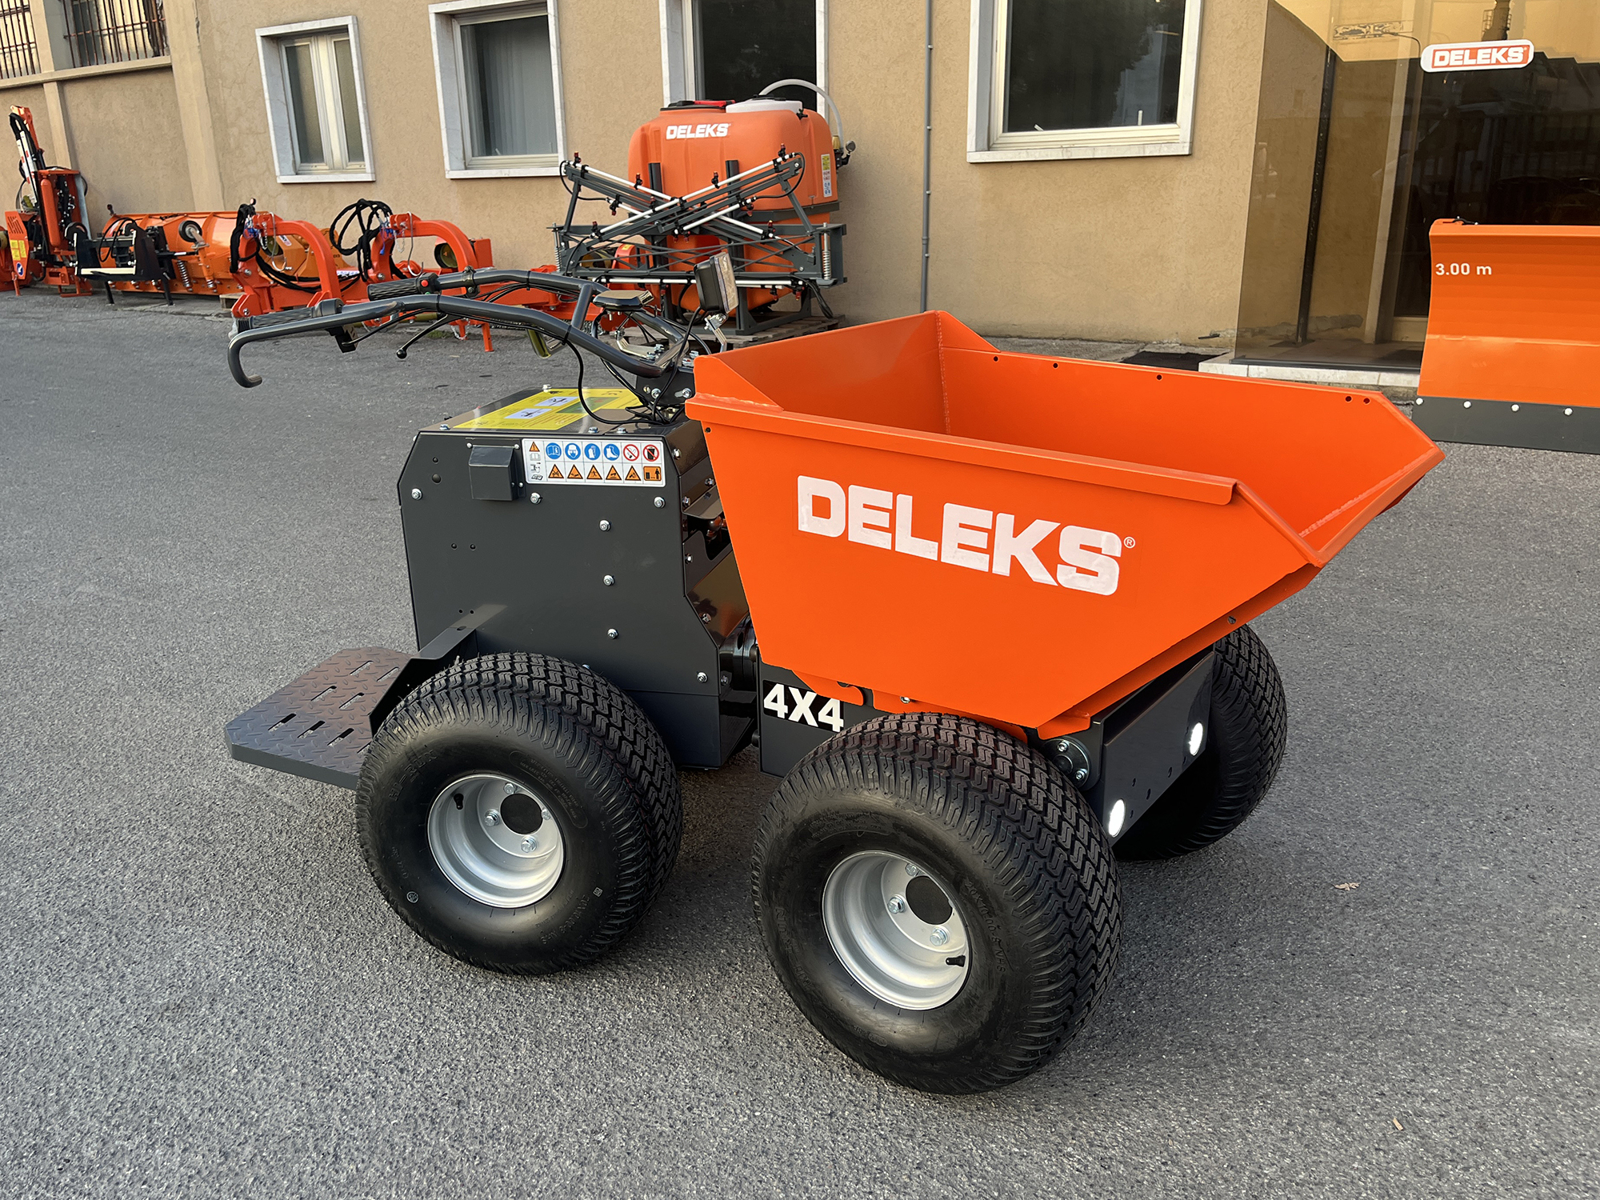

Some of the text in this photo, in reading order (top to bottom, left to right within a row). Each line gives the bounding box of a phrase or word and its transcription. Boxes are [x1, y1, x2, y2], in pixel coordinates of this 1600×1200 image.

[1435, 262, 1492, 276] 3.00 m
[763, 683, 844, 733] 4X4
